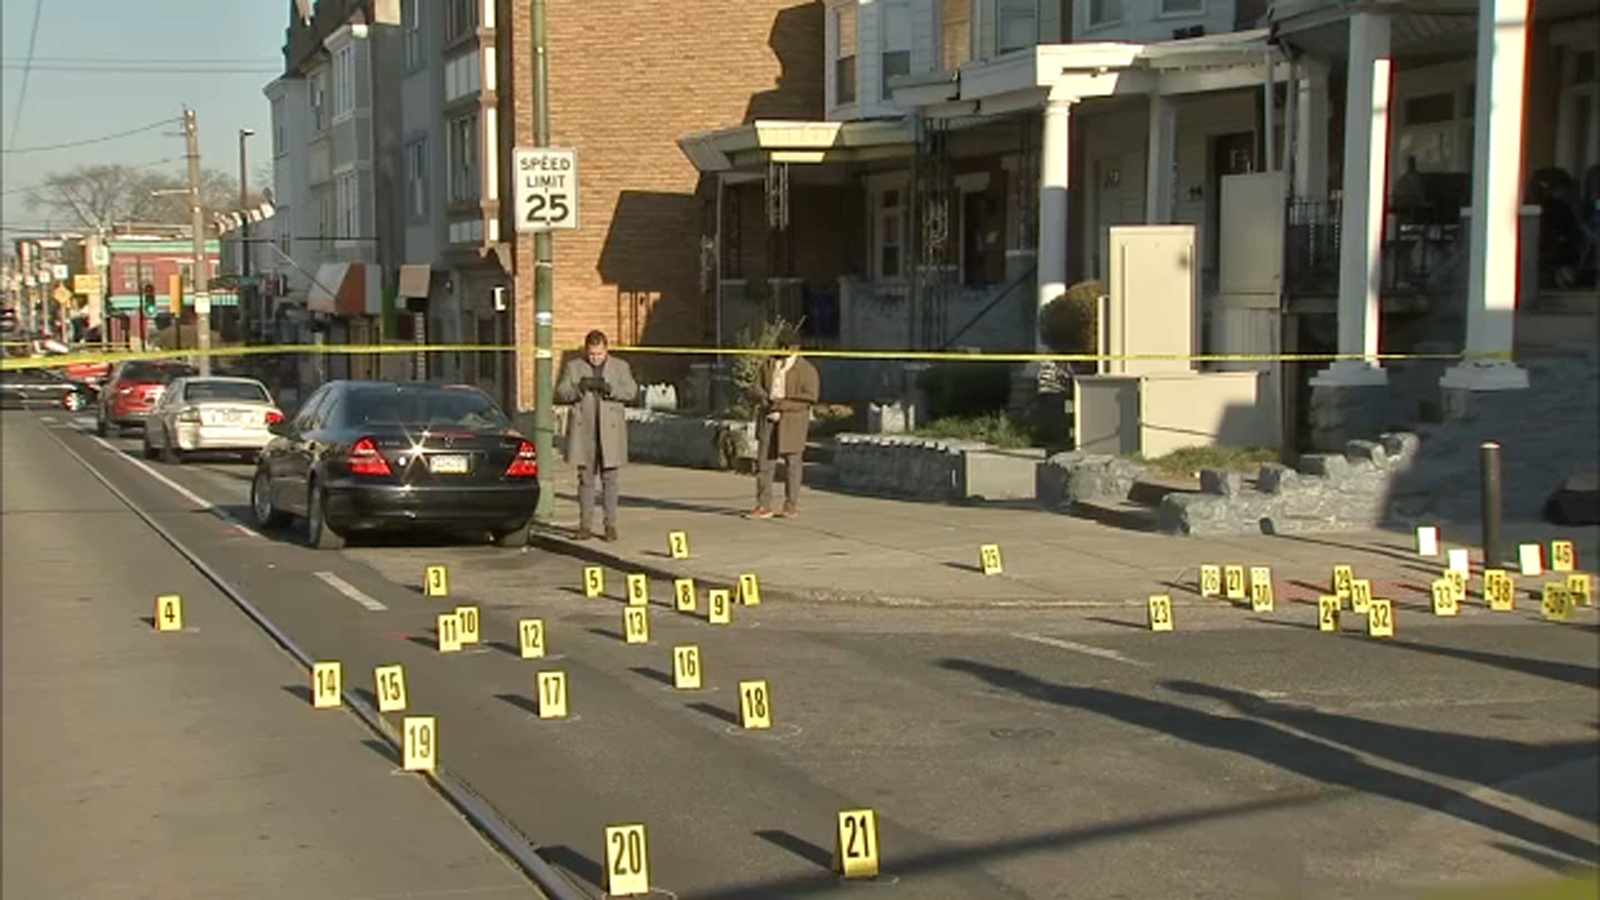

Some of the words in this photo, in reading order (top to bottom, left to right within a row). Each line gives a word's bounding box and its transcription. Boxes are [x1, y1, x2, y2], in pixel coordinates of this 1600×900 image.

[520, 157, 570, 170] SPEED
[526, 175, 566, 188] LIMIT
[526, 194, 569, 222] 25
[675, 537, 684, 554] 2
[984, 549, 998, 568] 25
[432, 570, 441, 588] 3
[590, 568, 598, 588] 5
[634, 578, 642, 598] 6
[1204, 570, 1218, 591] 26
[1228, 570, 1241, 591] 27
[682, 584, 690, 604] 8
[1254, 584, 1270, 606] 30
[1354, 584, 1368, 606] 31
[1494, 580, 1511, 602] 38
[164, 602, 176, 624] 4
[714, 594, 724, 616] 9
[1152, 600, 1168, 624] 23
[1372, 604, 1390, 628] 32
[444, 620, 456, 642] 11
[460, 611, 474, 633] 10
[628, 611, 644, 636] 13
[523, 625, 540, 648] 12
[678, 650, 696, 676] 16
[317, 670, 336, 698] 14
[380, 672, 400, 701] 15
[542, 677, 560, 706] 17
[745, 688, 766, 718] 18
[409, 724, 431, 758] 19
[844, 816, 870, 858] 21
[612, 830, 642, 876] 20
